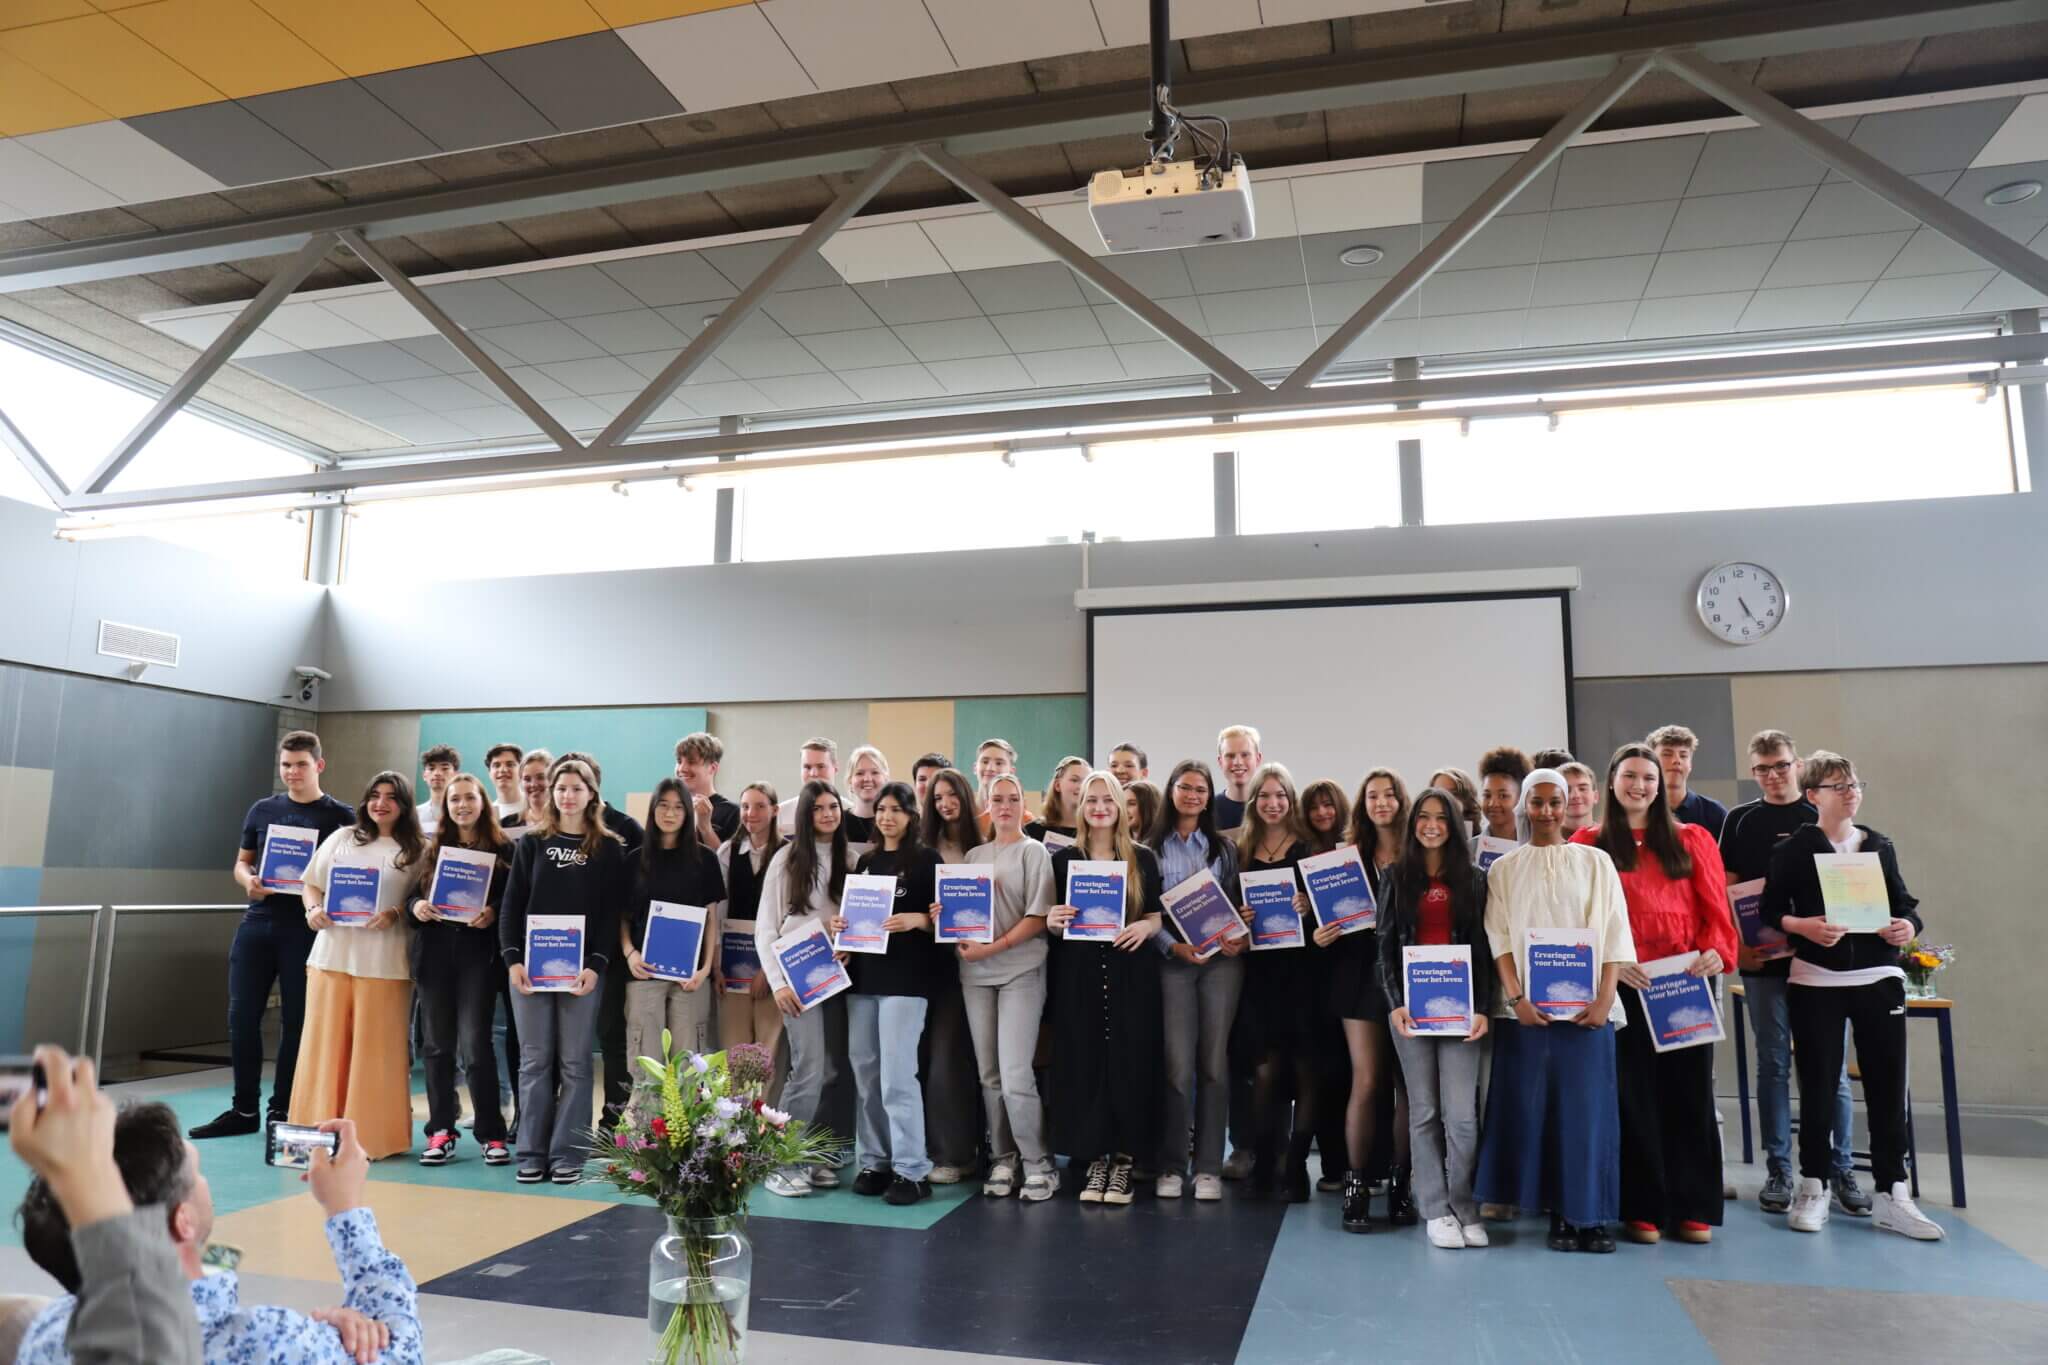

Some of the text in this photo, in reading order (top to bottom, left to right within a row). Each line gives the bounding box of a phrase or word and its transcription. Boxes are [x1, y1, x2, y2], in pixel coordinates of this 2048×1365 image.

[1733, 570, 1744, 578] 12
[1763, 582, 1771, 590] 2
[1709, 587, 1719, 595] 10
[1769, 595, 1776, 604] 3
[1713, 614, 1721, 622] 8
[1724, 624, 1732, 632] 7
[1757, 621, 1765, 629] 5
[1742, 626, 1750, 635] 6
[546, 846, 588, 865] Nike
[1534, 952, 1576, 960] Ervaringen
[1679, 984, 1700, 993] leven
